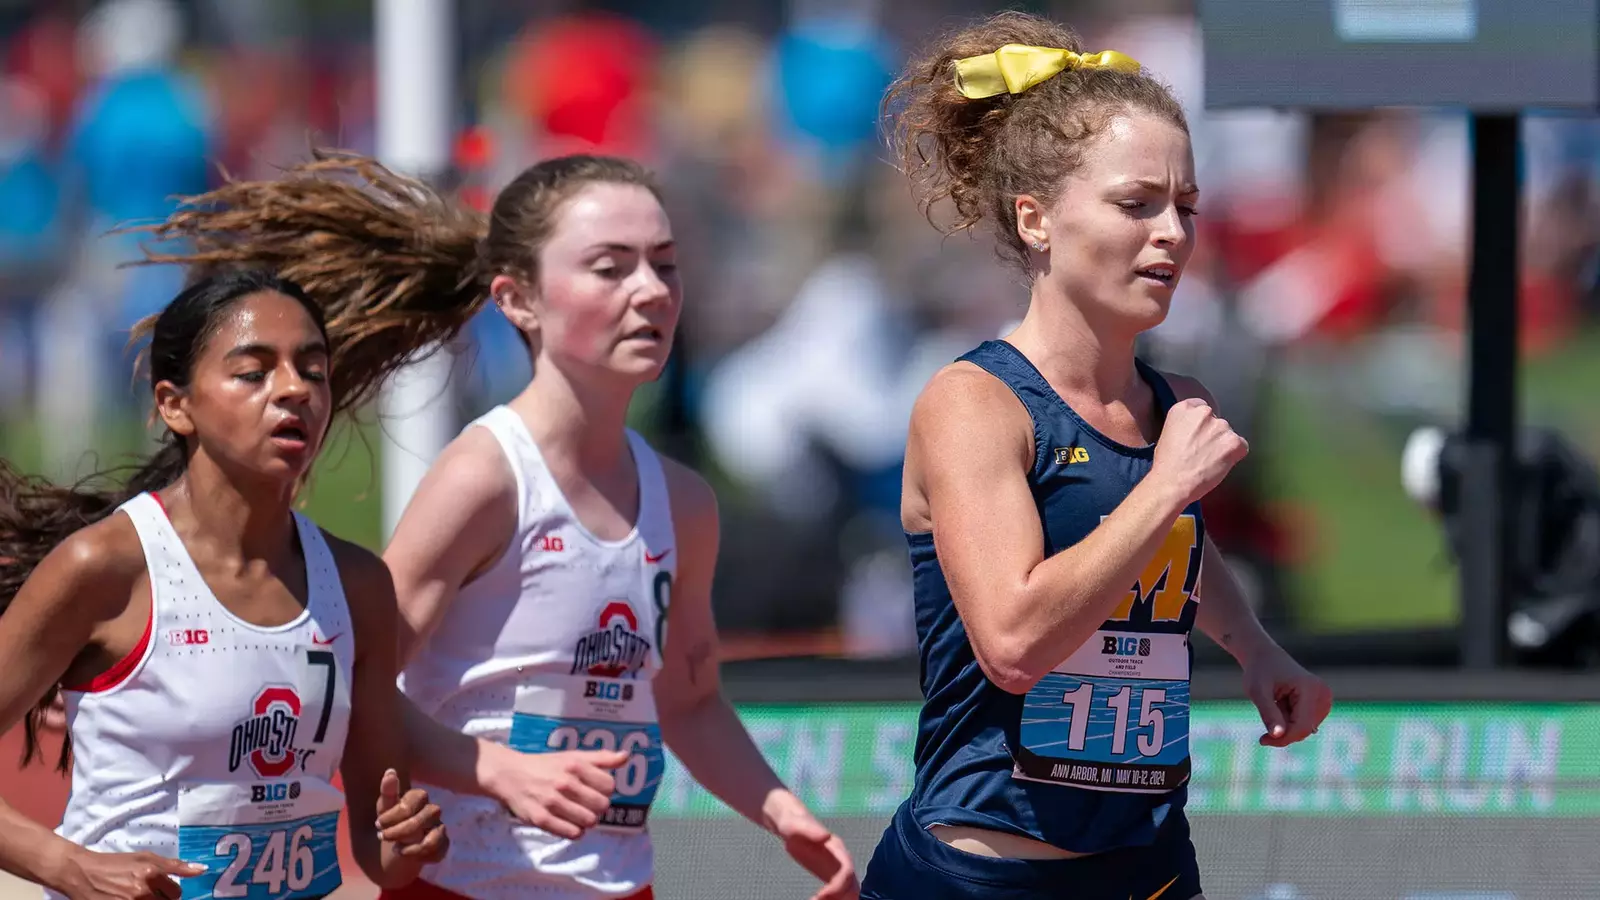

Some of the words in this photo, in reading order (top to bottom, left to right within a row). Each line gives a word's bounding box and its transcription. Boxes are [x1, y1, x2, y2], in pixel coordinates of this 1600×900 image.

[307, 651, 335, 743] 7
[1062, 682, 1167, 757] 115
[229, 716, 270, 772] OHIO
[1050, 763, 1070, 779] ANN
[1070, 765, 1099, 782] ARBOR,
[1101, 768, 1112, 783] MI
[1116, 769, 1131, 784] MAY
[1149, 771, 1165, 785] 2024
[1388, 717, 1562, 808] RUN
[212, 825, 314, 898] 246
